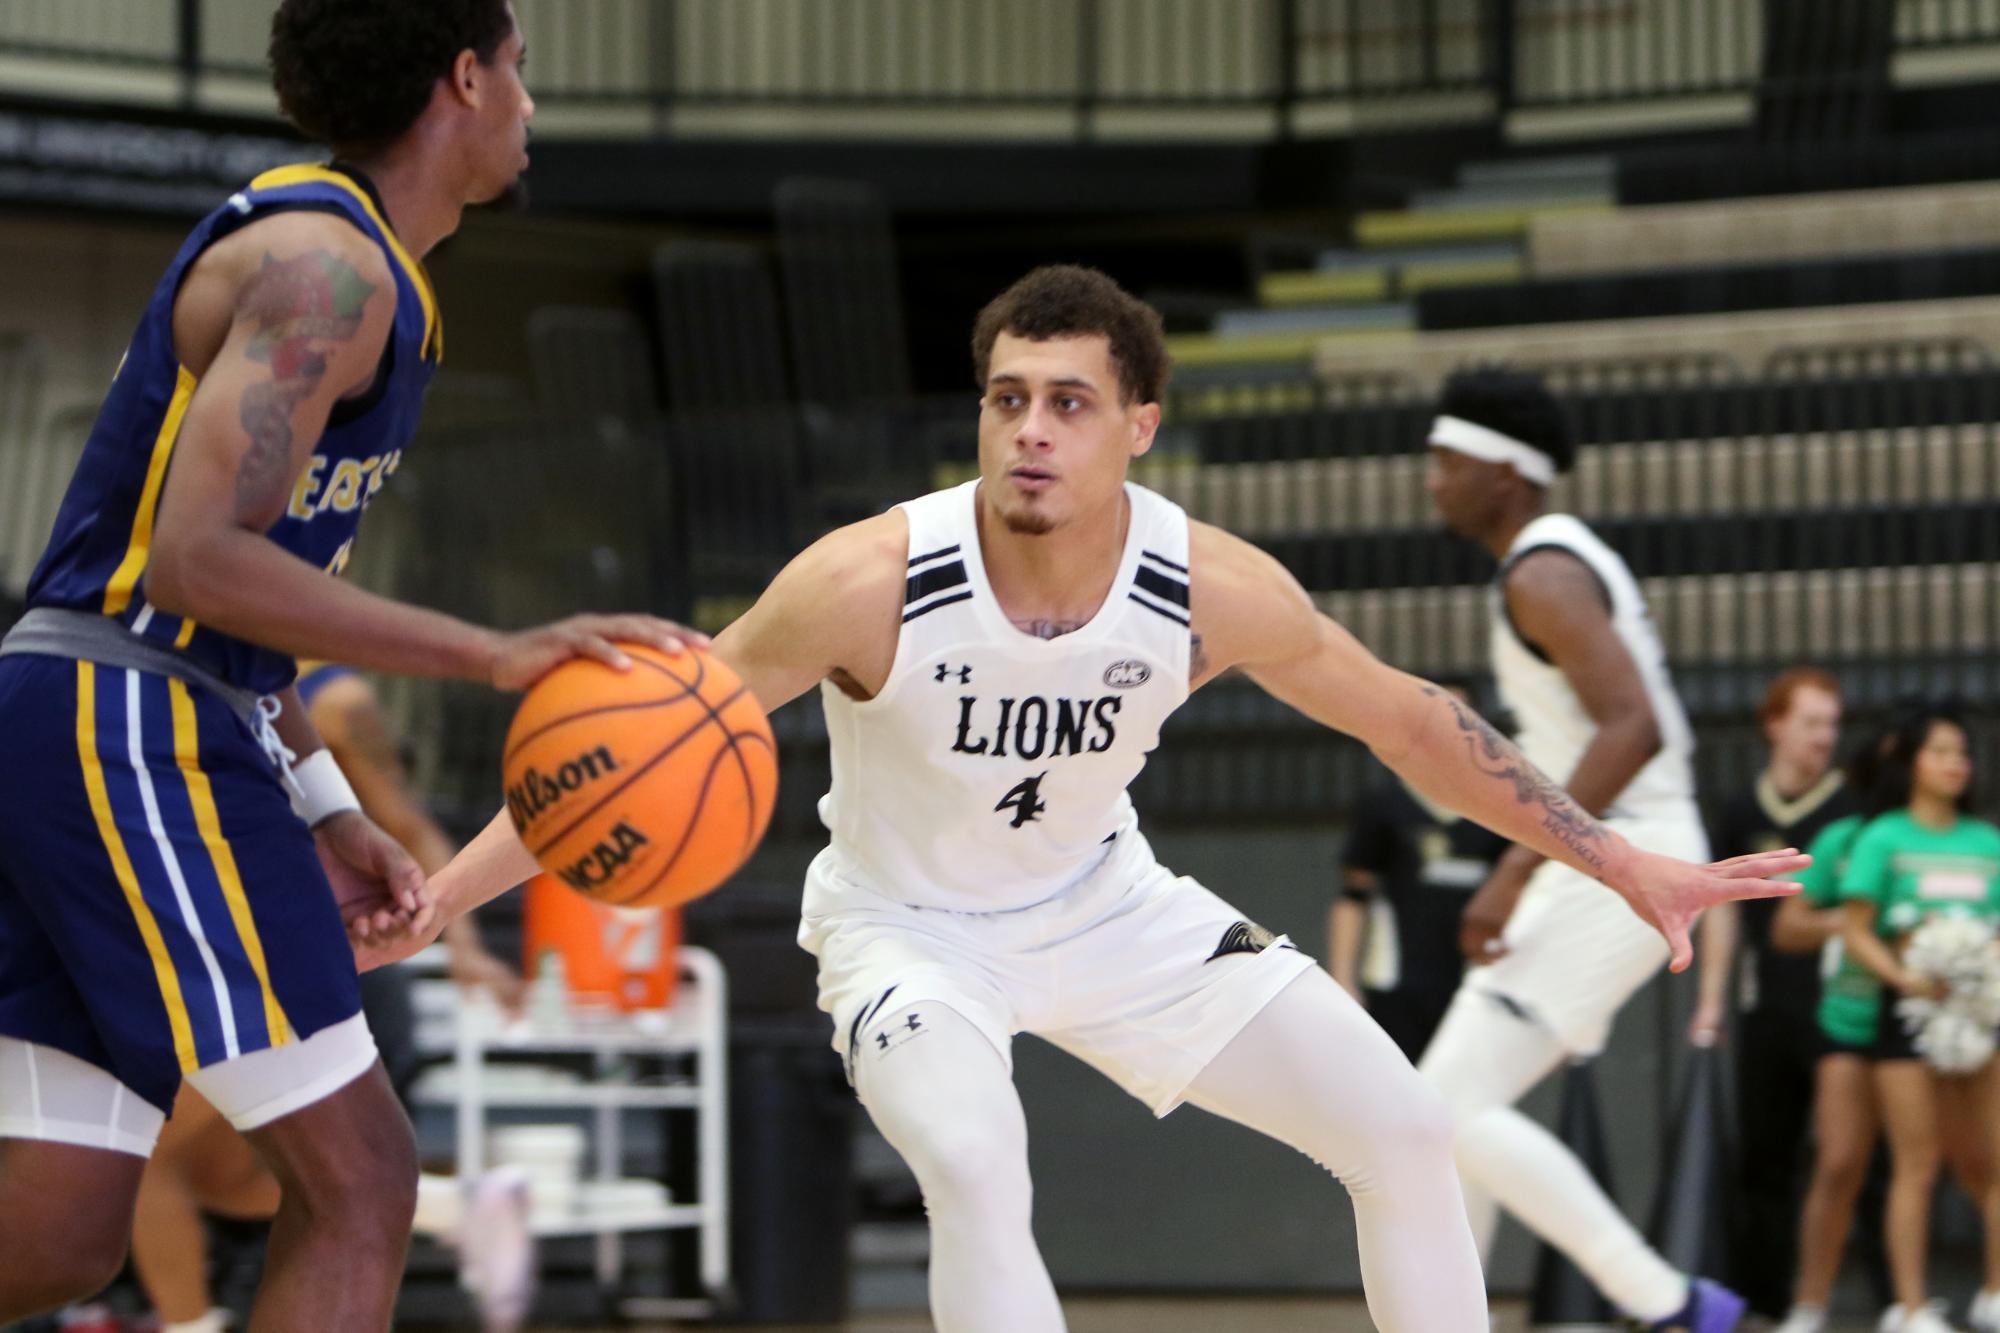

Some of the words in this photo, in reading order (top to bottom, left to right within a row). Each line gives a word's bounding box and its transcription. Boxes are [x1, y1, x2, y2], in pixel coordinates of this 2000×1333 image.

[951, 695, 1122, 760] LIONS
[993, 769, 1048, 828] 4
[556, 820, 649, 891] NCAA
